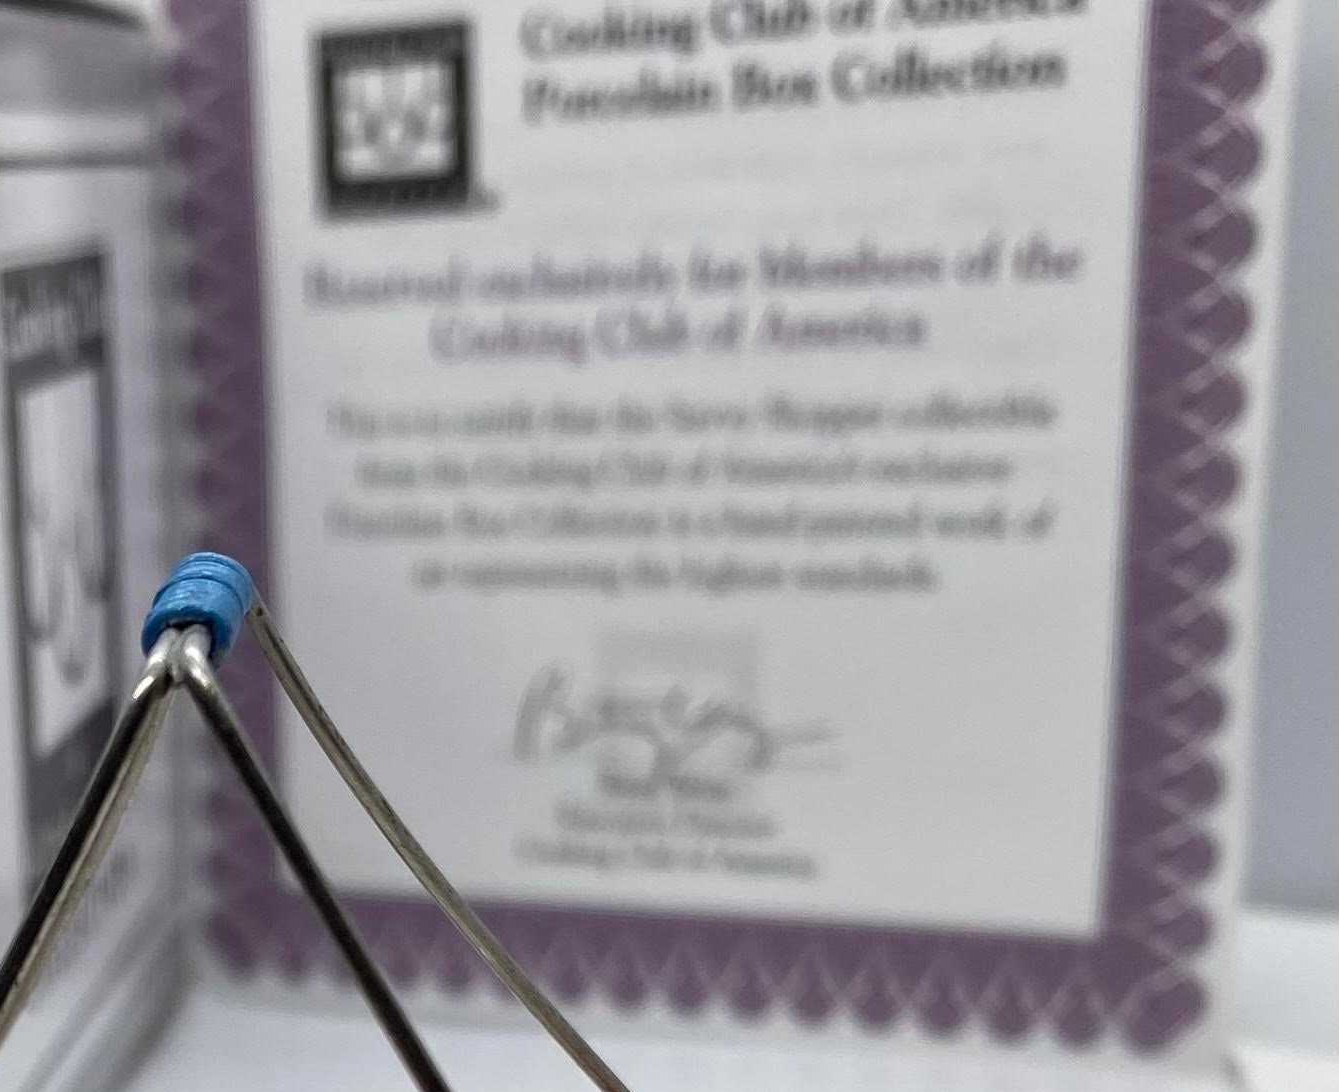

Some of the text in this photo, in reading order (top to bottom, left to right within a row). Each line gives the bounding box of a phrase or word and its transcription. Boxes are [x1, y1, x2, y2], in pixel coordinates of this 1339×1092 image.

[517, 8, 700, 60] Cooking
[708, 0, 812, 46] Club
[823, 0, 874, 35] of
[520, 38, 1068, 126] Porcelain Box Collection
[759, 239, 944, 290] Members
[957, 228, 1006, 285] of
[1010, 227, 1082, 283] the
[428, 306, 590, 366] Cooking
[595, 302, 690, 358] Club
[757, 298, 928, 350] America
